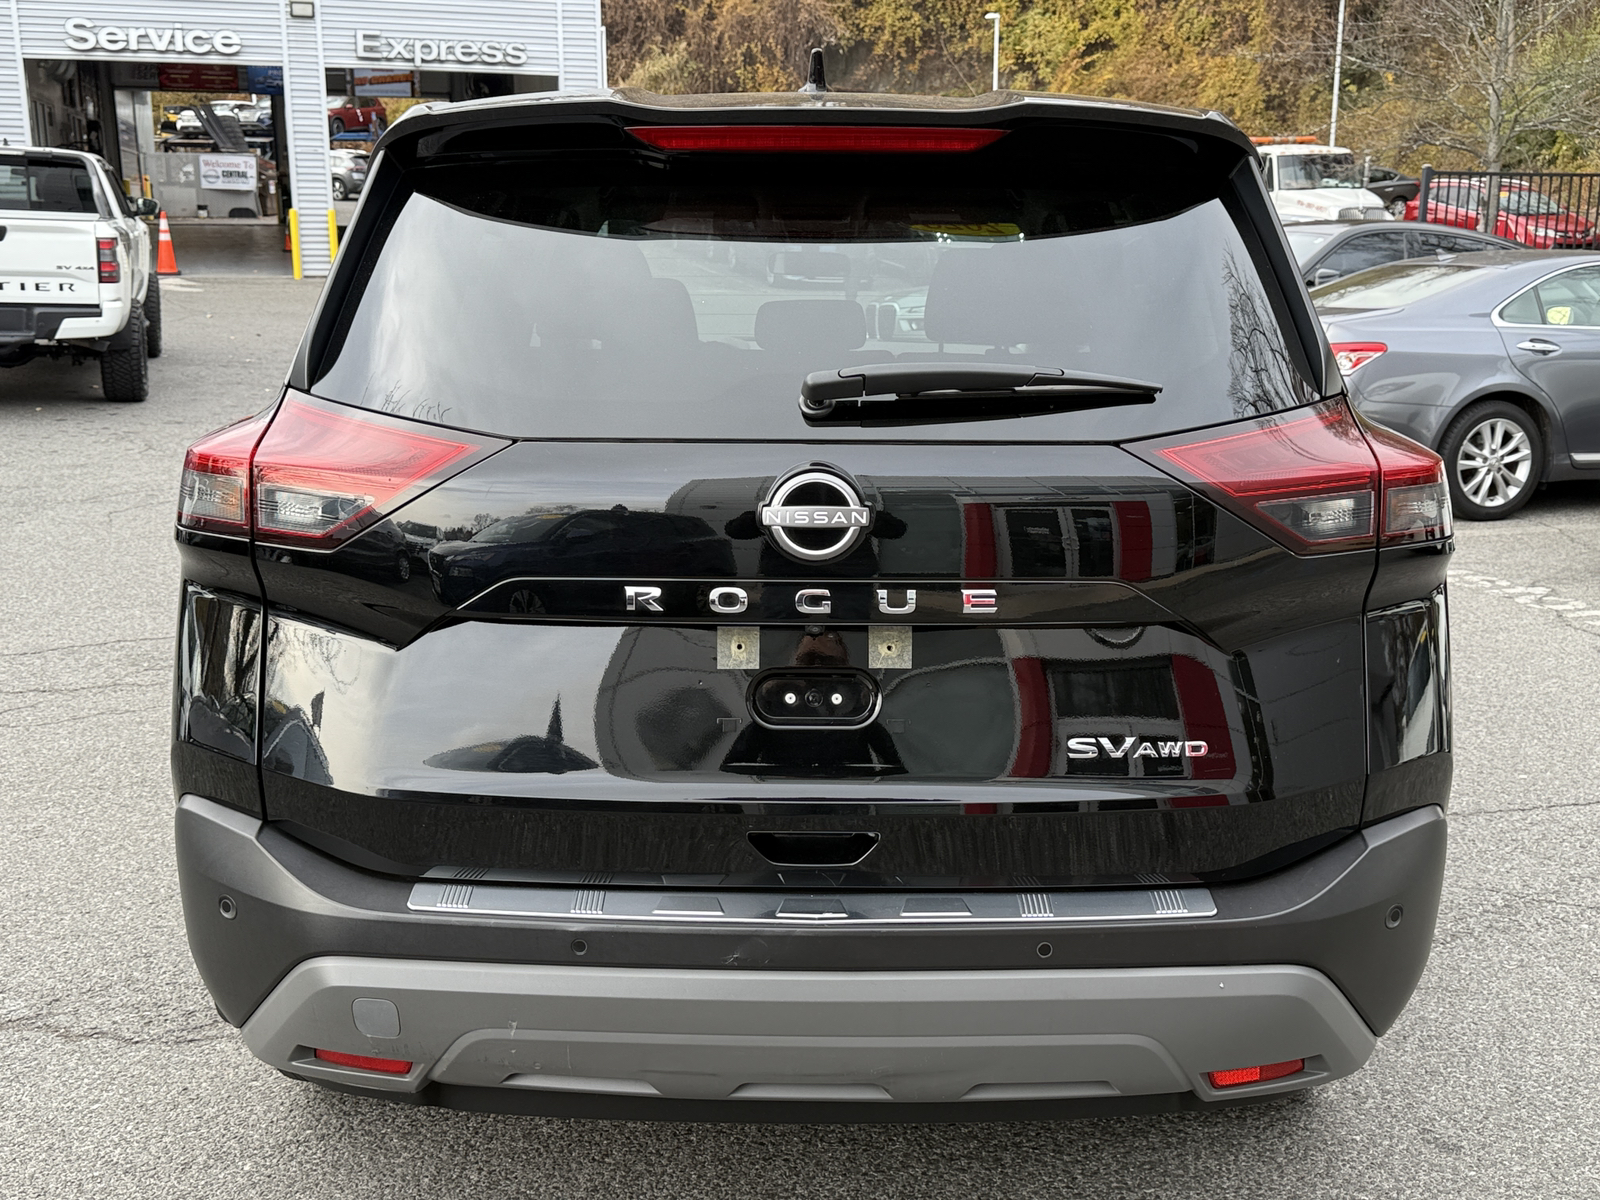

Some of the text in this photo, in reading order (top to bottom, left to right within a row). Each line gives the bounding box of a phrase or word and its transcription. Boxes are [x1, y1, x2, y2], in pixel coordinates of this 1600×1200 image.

[64, 17, 242, 54] Service
[356, 29, 528, 67] Express
[202, 159, 254, 169] Welcome To
[766, 511, 867, 524] NISSAN
[623, 586, 998, 614] ROGUE
[1067, 737, 1209, 758] SV AWD
